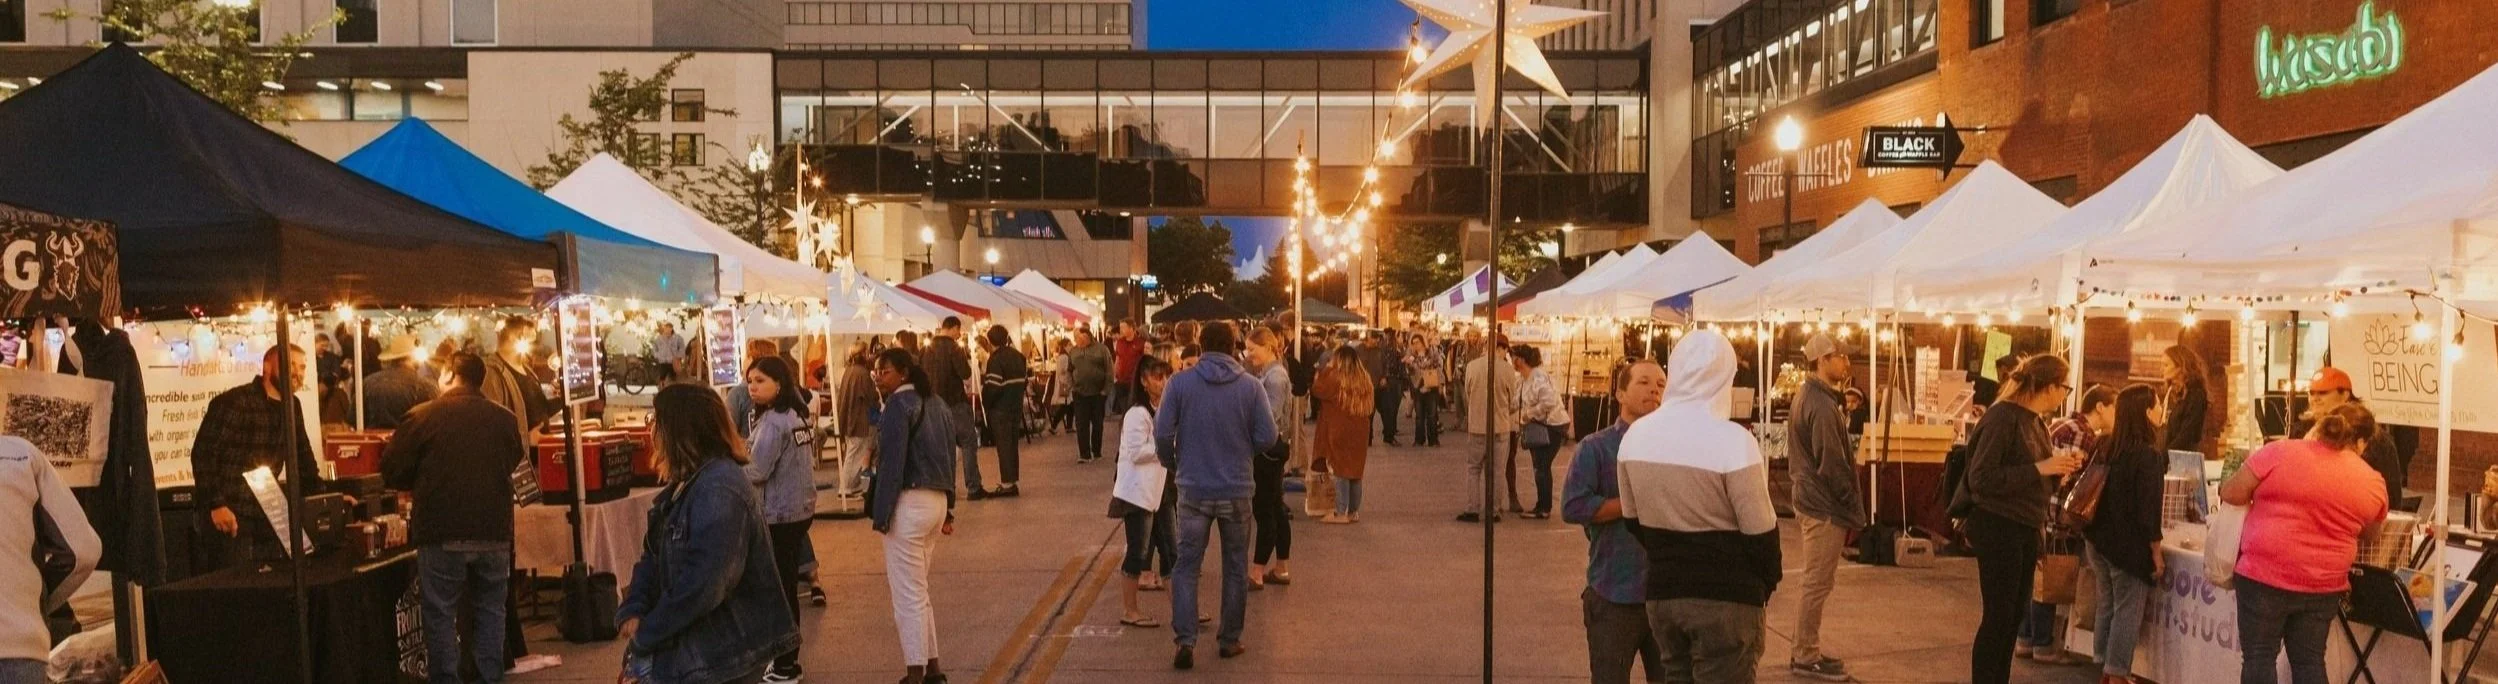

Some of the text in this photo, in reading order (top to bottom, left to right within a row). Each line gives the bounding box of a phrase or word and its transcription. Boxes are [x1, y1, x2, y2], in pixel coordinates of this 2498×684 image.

[1883, 137, 1935, 151] BLACK
[1748, 138, 1852, 203] COFFEE WAFFLES
[3, 239, 40, 291] G
[2372, 361, 2439, 395] BEING
[145, 390, 189, 403] ncredible
[163, 408, 185, 423] Fresh
[154, 450, 169, 464] you
[2160, 567, 2217, 605] oore
